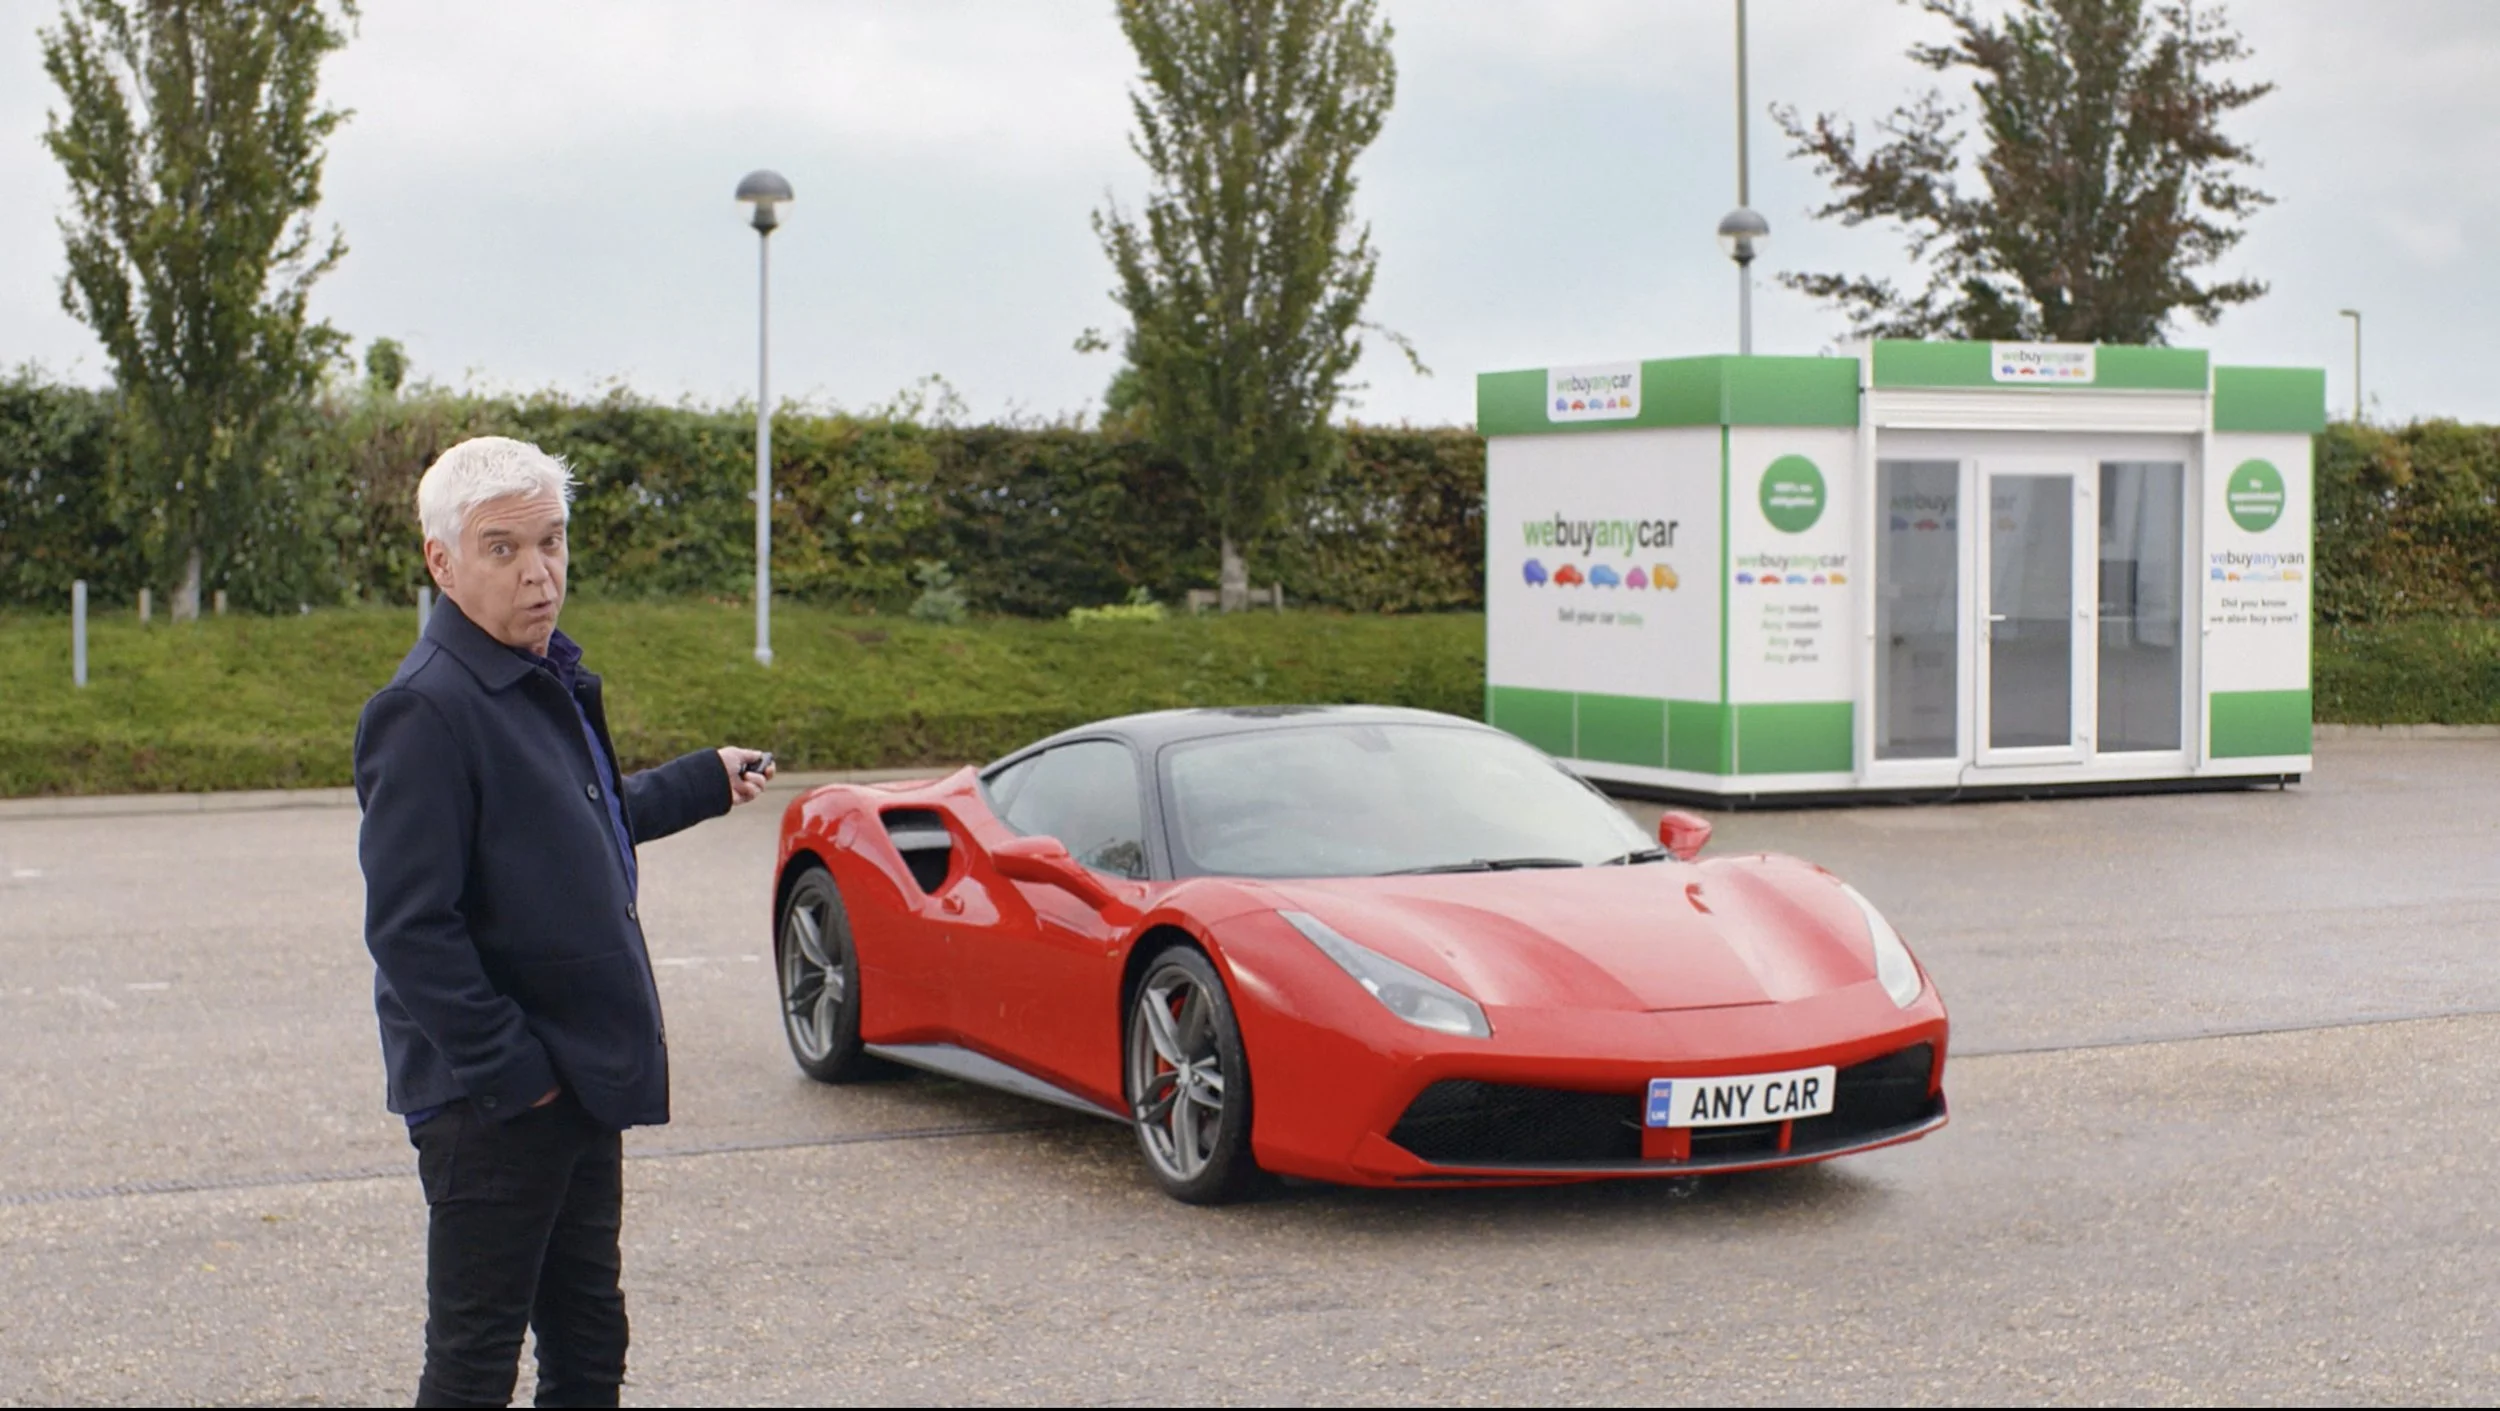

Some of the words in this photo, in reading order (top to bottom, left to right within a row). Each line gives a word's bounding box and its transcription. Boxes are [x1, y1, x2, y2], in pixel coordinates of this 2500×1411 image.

[2002, 350, 2085, 364] webuyanycar
[1556, 373, 1633, 395] webuyanycar
[1522, 511, 1679, 557] webuyanycar
[1736, 551, 1846, 572] webuyanycar
[1691, 1084, 1754, 1120] ANY
[1764, 1077, 1819, 1114] CAR
